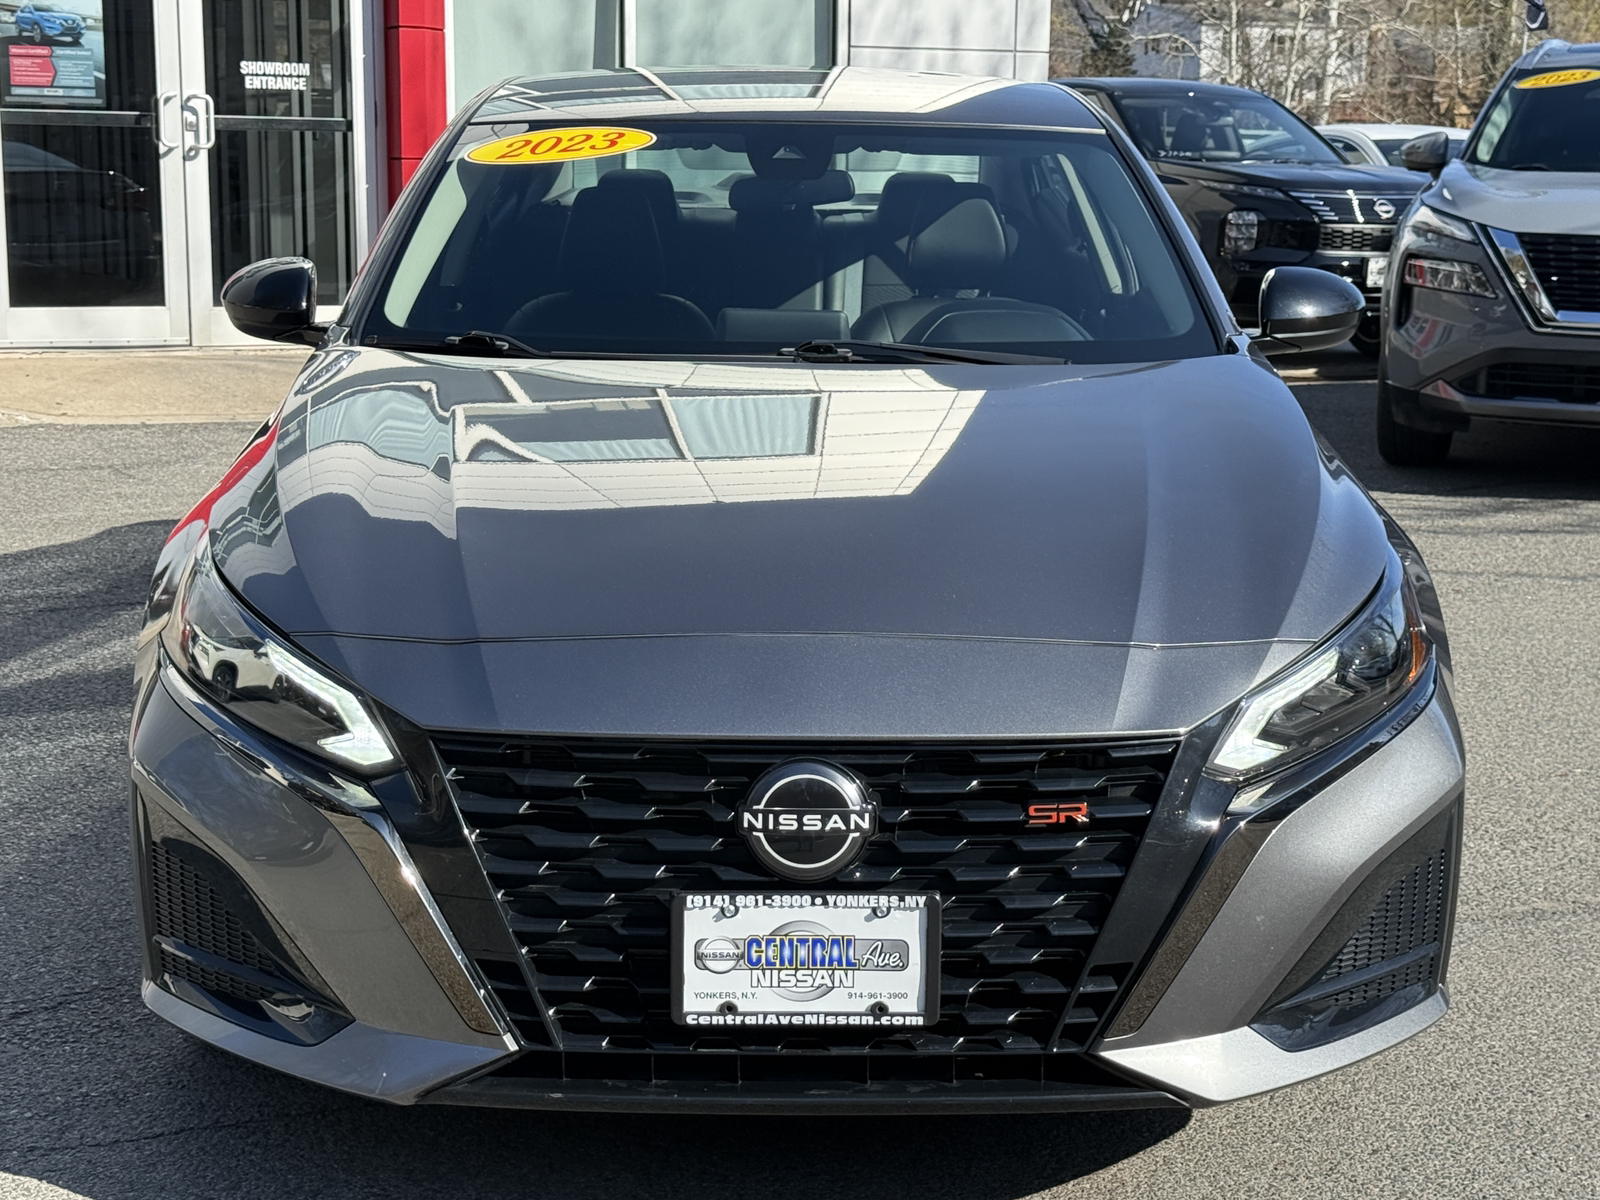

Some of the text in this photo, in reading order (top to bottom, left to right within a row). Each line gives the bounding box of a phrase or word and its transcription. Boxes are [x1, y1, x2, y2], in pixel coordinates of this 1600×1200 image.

[240, 61, 311, 76] SHOWROOM
[244, 76, 307, 91] ENTRANCE
[495, 132, 626, 160] 2023
[1028, 802, 1090, 824] SR
[743, 812, 870, 831] NISSAN
[735, 895, 812, 908] 961-3900
[700, 951, 740, 959] NISSAN
[744, 935, 905, 969] CENTRAL Ave.
[750, 969, 855, 988] NISSAN
[693, 991, 758, 1001] YONKERS, N.Y.
[847, 991, 908, 1000] 914-961-3900
[685, 1013, 924, 1026] CentralAveNissan.com
